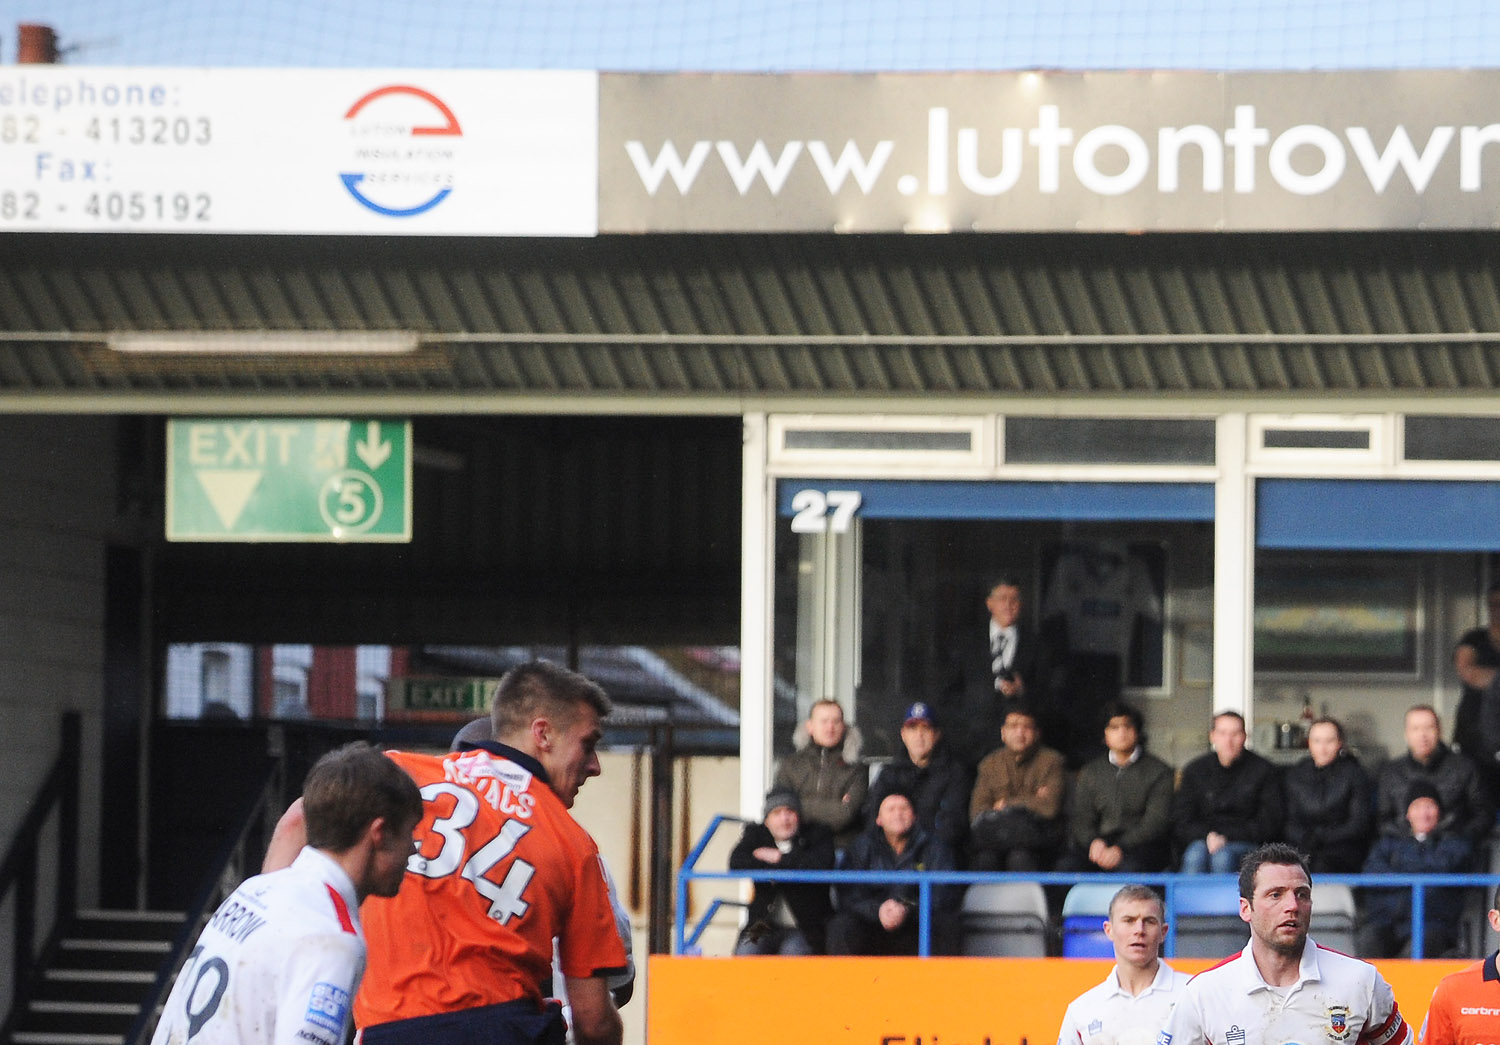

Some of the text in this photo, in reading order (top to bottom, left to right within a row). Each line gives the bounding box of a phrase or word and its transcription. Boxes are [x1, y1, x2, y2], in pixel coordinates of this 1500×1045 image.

[86, 116, 212, 145] 413203
[36, 152, 112, 181] Fax:
[85, 192, 212, 221] 405192
[190, 423, 299, 466] EXIT
[336, 481, 366, 524] 5
[791, 489, 862, 533] 27
[443, 756, 536, 818] KACS
[406, 782, 536, 926] 34
